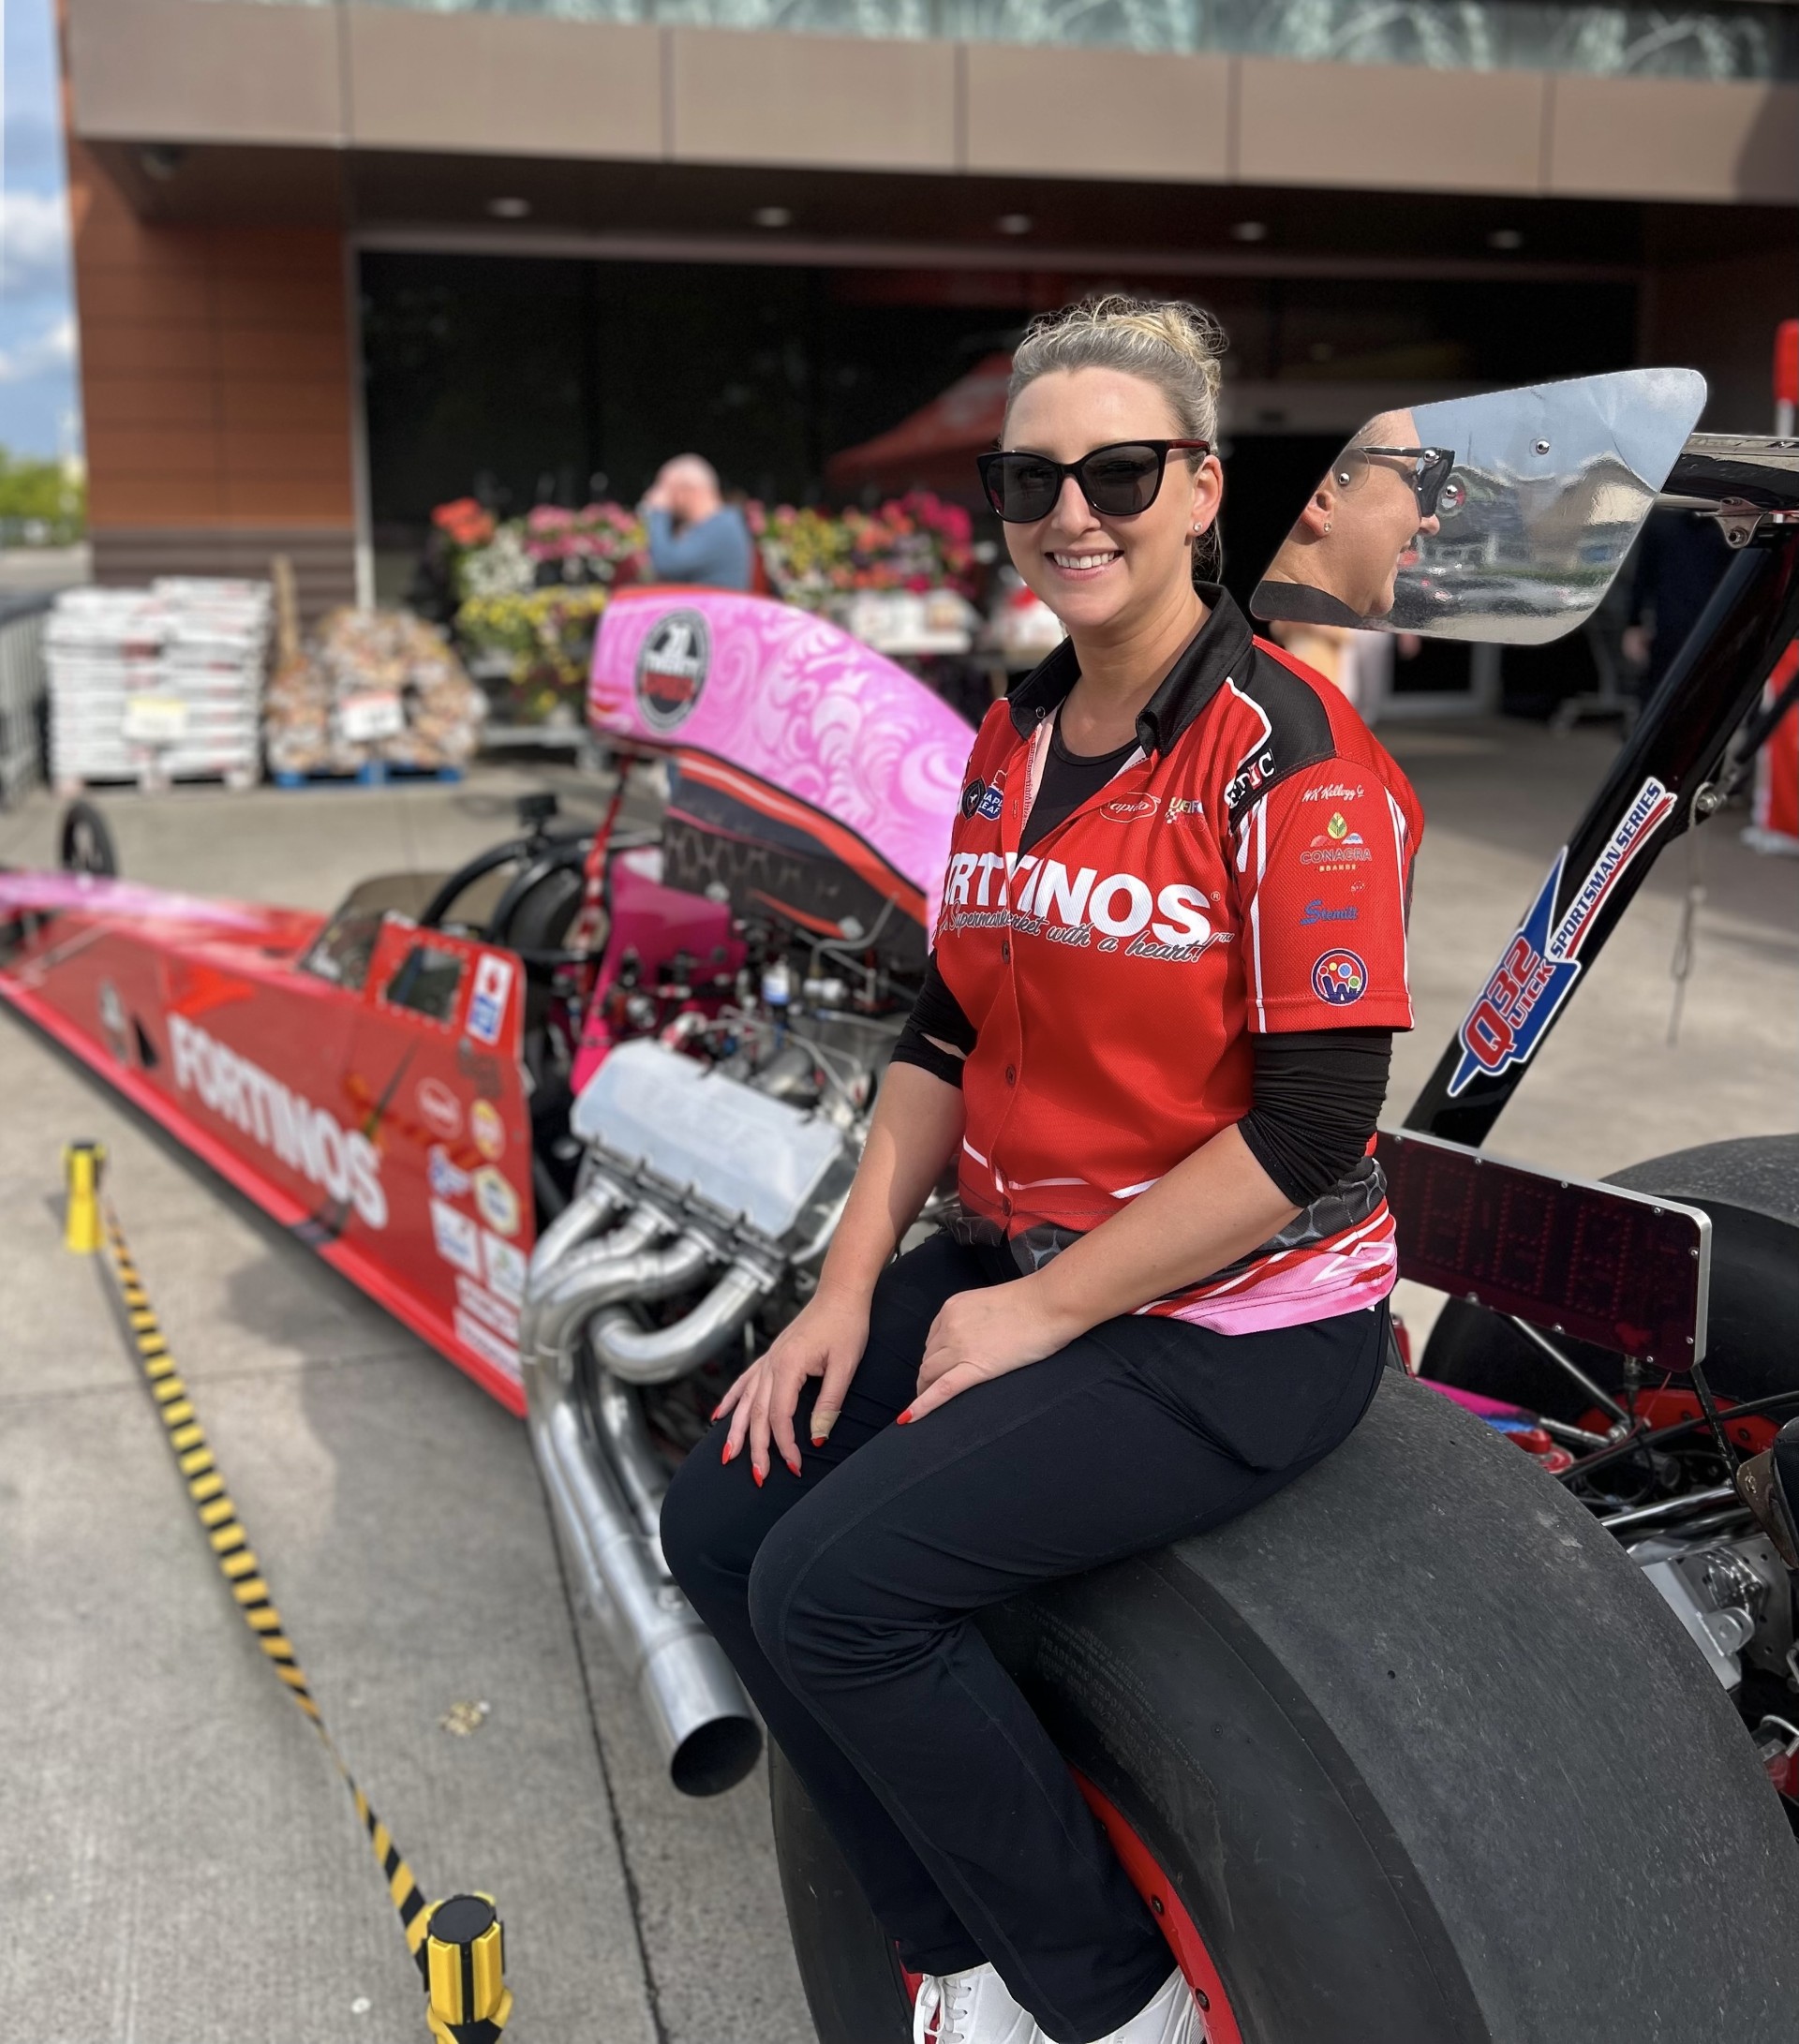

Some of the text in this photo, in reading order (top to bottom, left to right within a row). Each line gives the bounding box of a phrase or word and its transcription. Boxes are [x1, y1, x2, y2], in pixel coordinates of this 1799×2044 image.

[1321, 783, 1356, 801] Kellogg
[1108, 800, 1151, 814] aputo
[1300, 847, 1373, 865] CONAGRA
[1550, 781, 1662, 958] SPORTSMAN SERIES
[1047, 922, 1094, 947] with
[1097, 937, 1119, 953] a
[168, 1012, 389, 1230] FORTINOS
